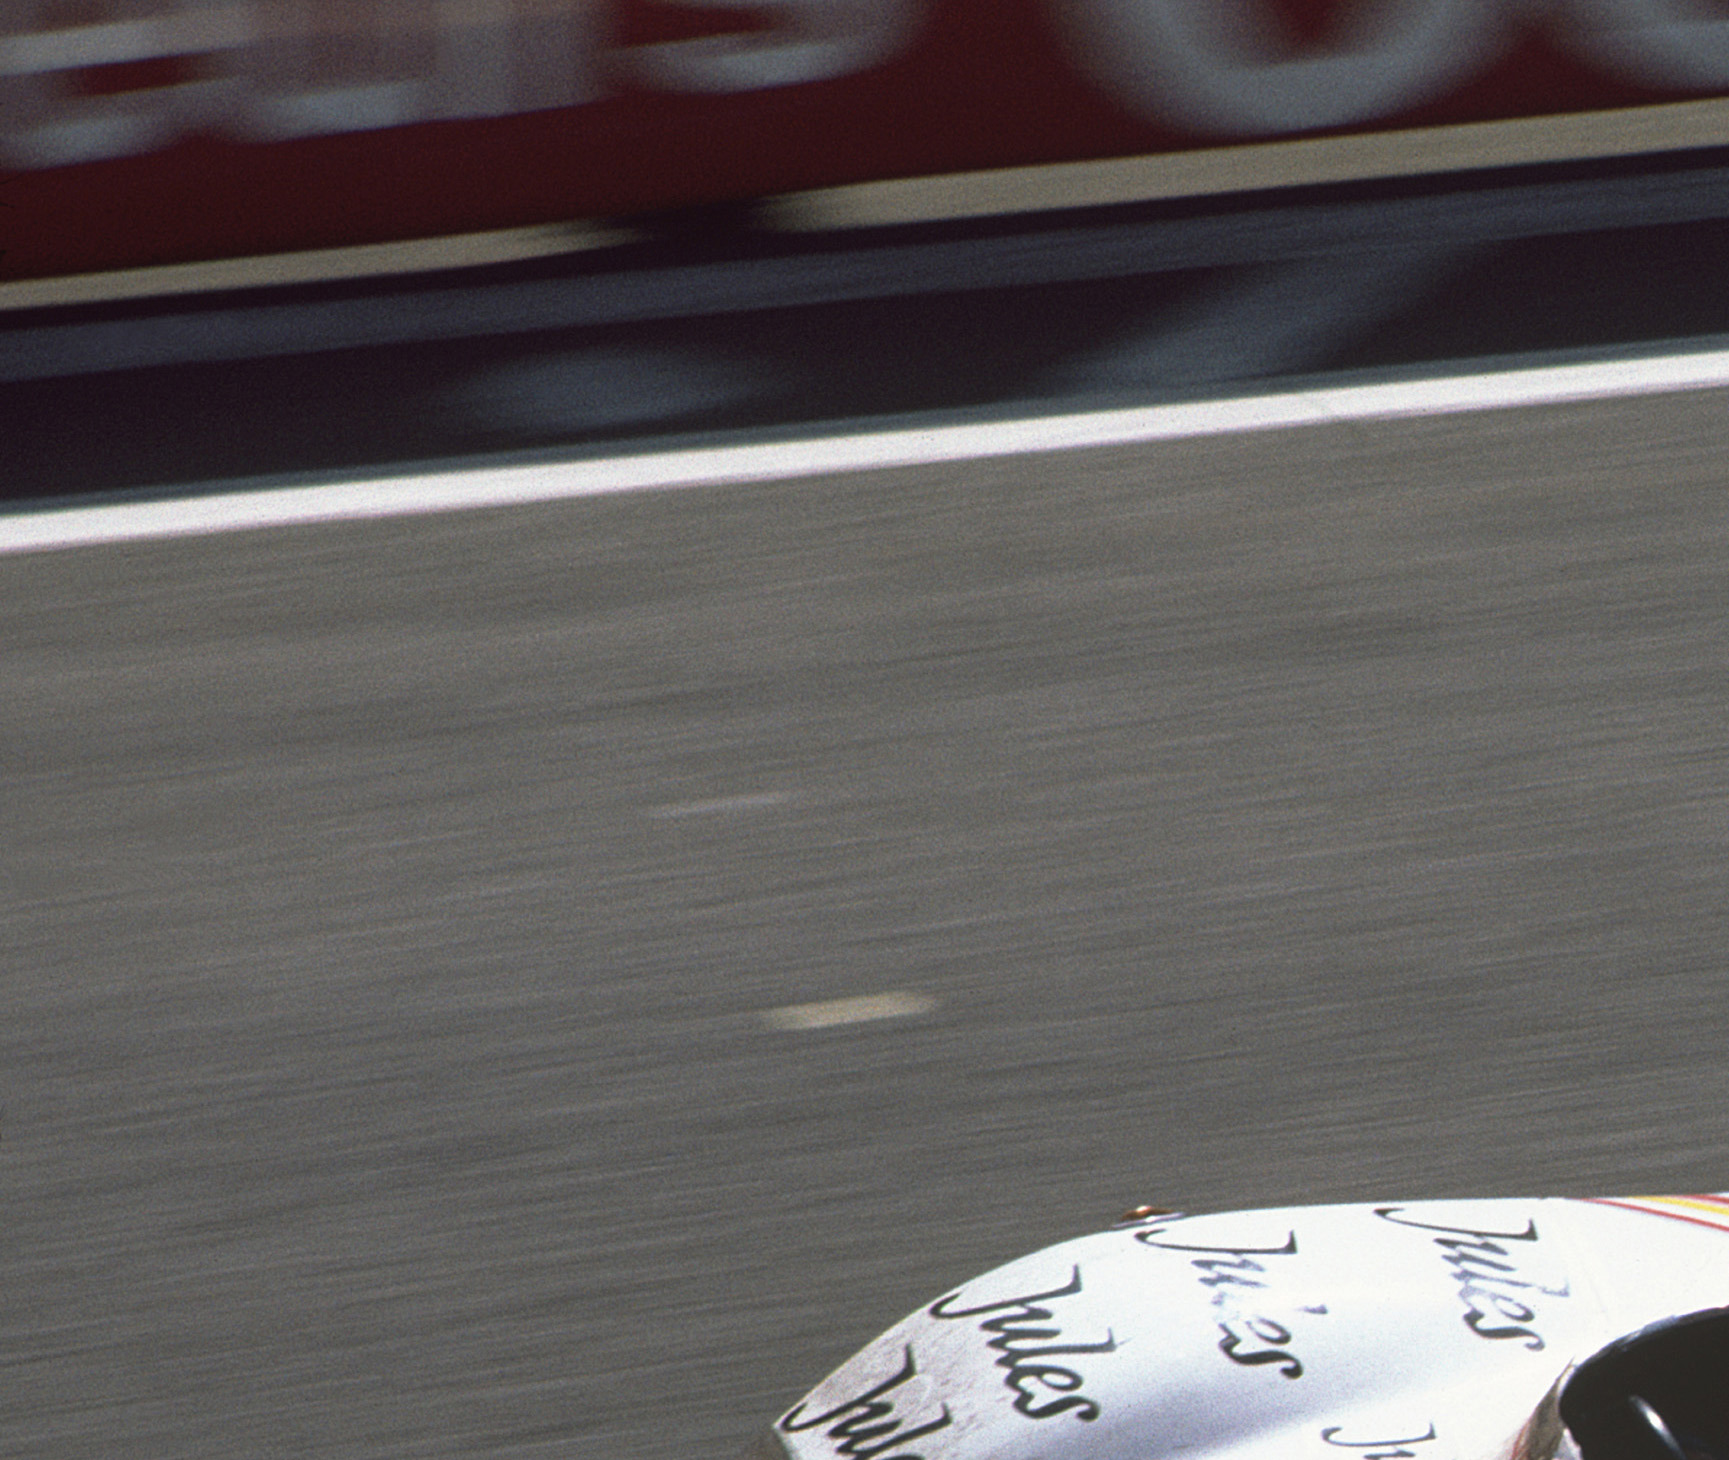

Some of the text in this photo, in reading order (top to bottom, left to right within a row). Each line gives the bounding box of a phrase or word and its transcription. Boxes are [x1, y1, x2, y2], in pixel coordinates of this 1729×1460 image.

[929, 1263, 1117, 1422] Jules
[1134, 1228, 1328, 1379] Jues
[1375, 1208, 1571, 1351] Jules
